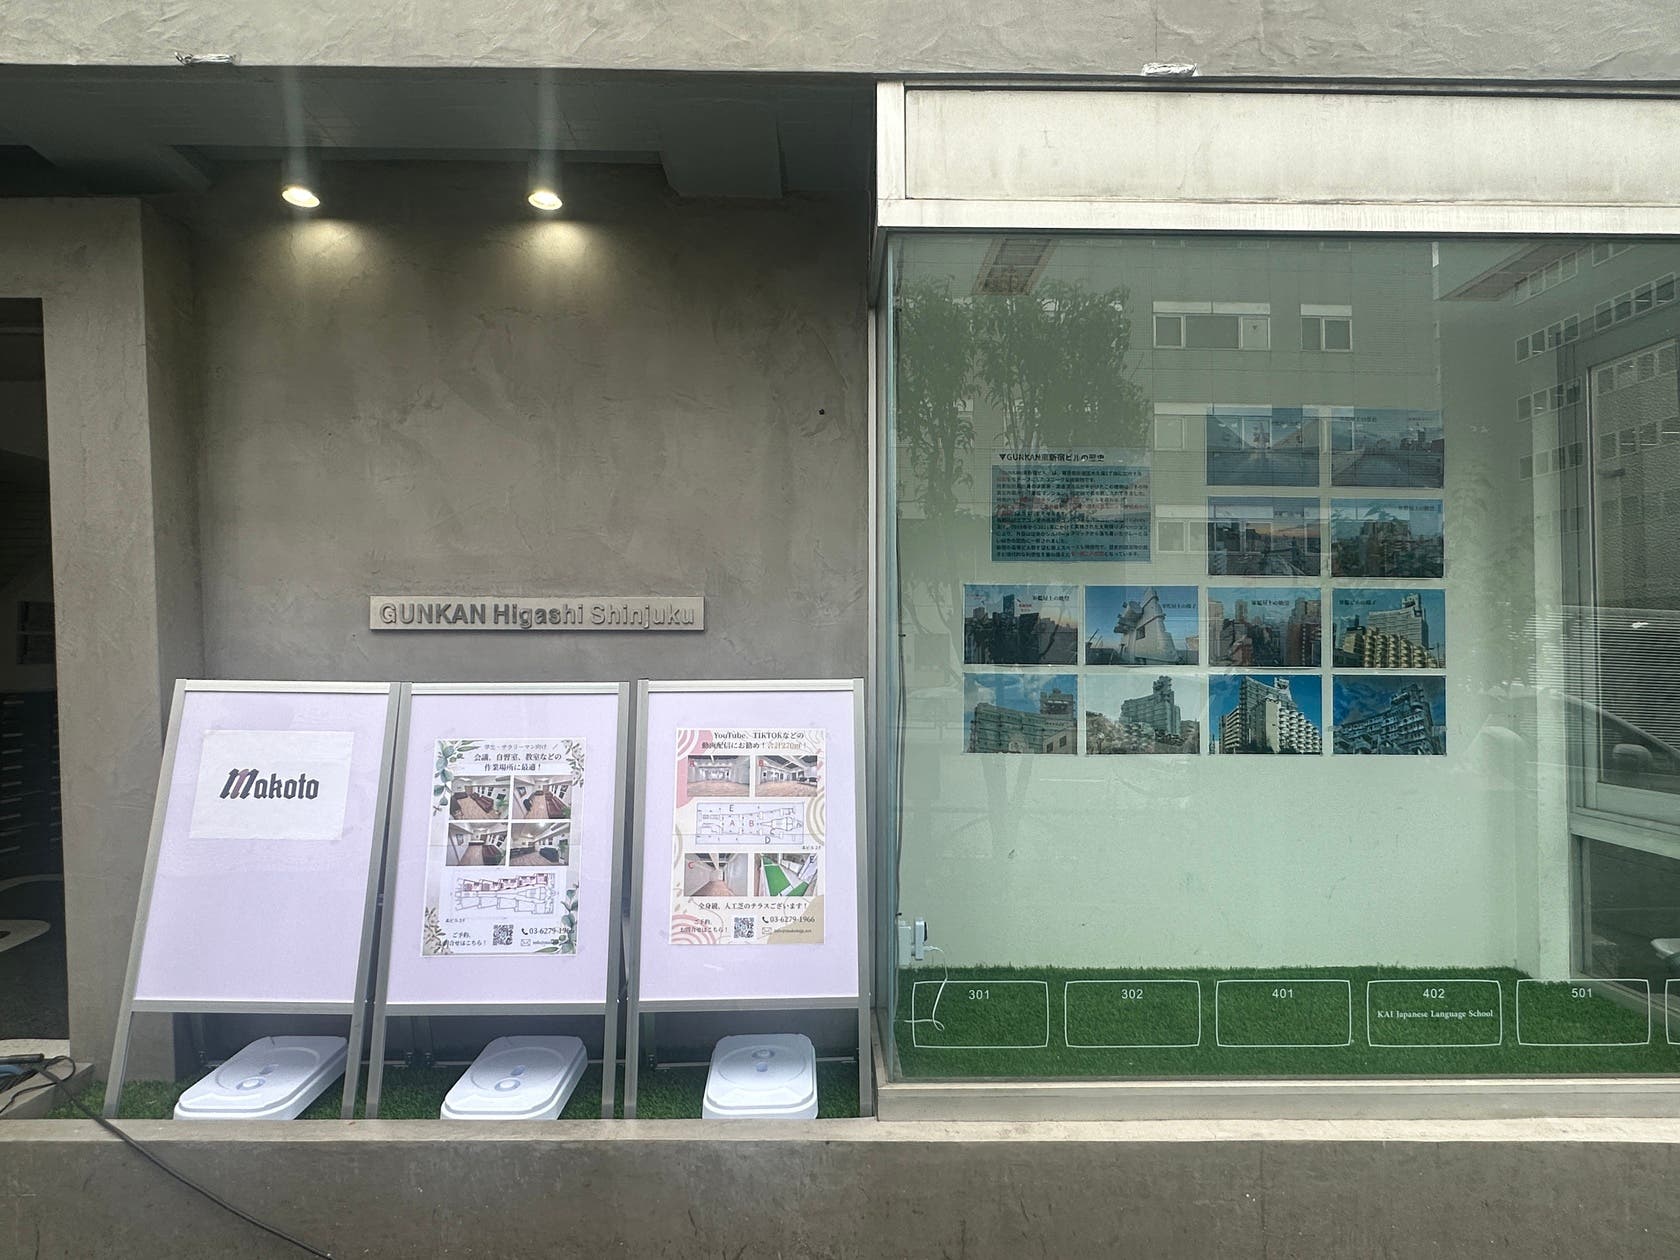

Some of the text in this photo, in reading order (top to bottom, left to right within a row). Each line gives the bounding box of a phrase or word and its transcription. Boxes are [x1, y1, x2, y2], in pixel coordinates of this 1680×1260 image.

[379, 602, 696, 629] GUNKAN Higashi Shinjuku
[219, 768, 320, 800] Makoto
[769, 916, 816, 924] 03-6279-1966
[968, 988, 991, 1000] 301
[1121, 988, 1144, 1000] 302
[1272, 988, 1294, 999] 401
[1422, 988, 1446, 999] 402
[1571, 987, 1593, 999] 501
[1377, 1009, 1494, 1021] KAI Japanese Language School
